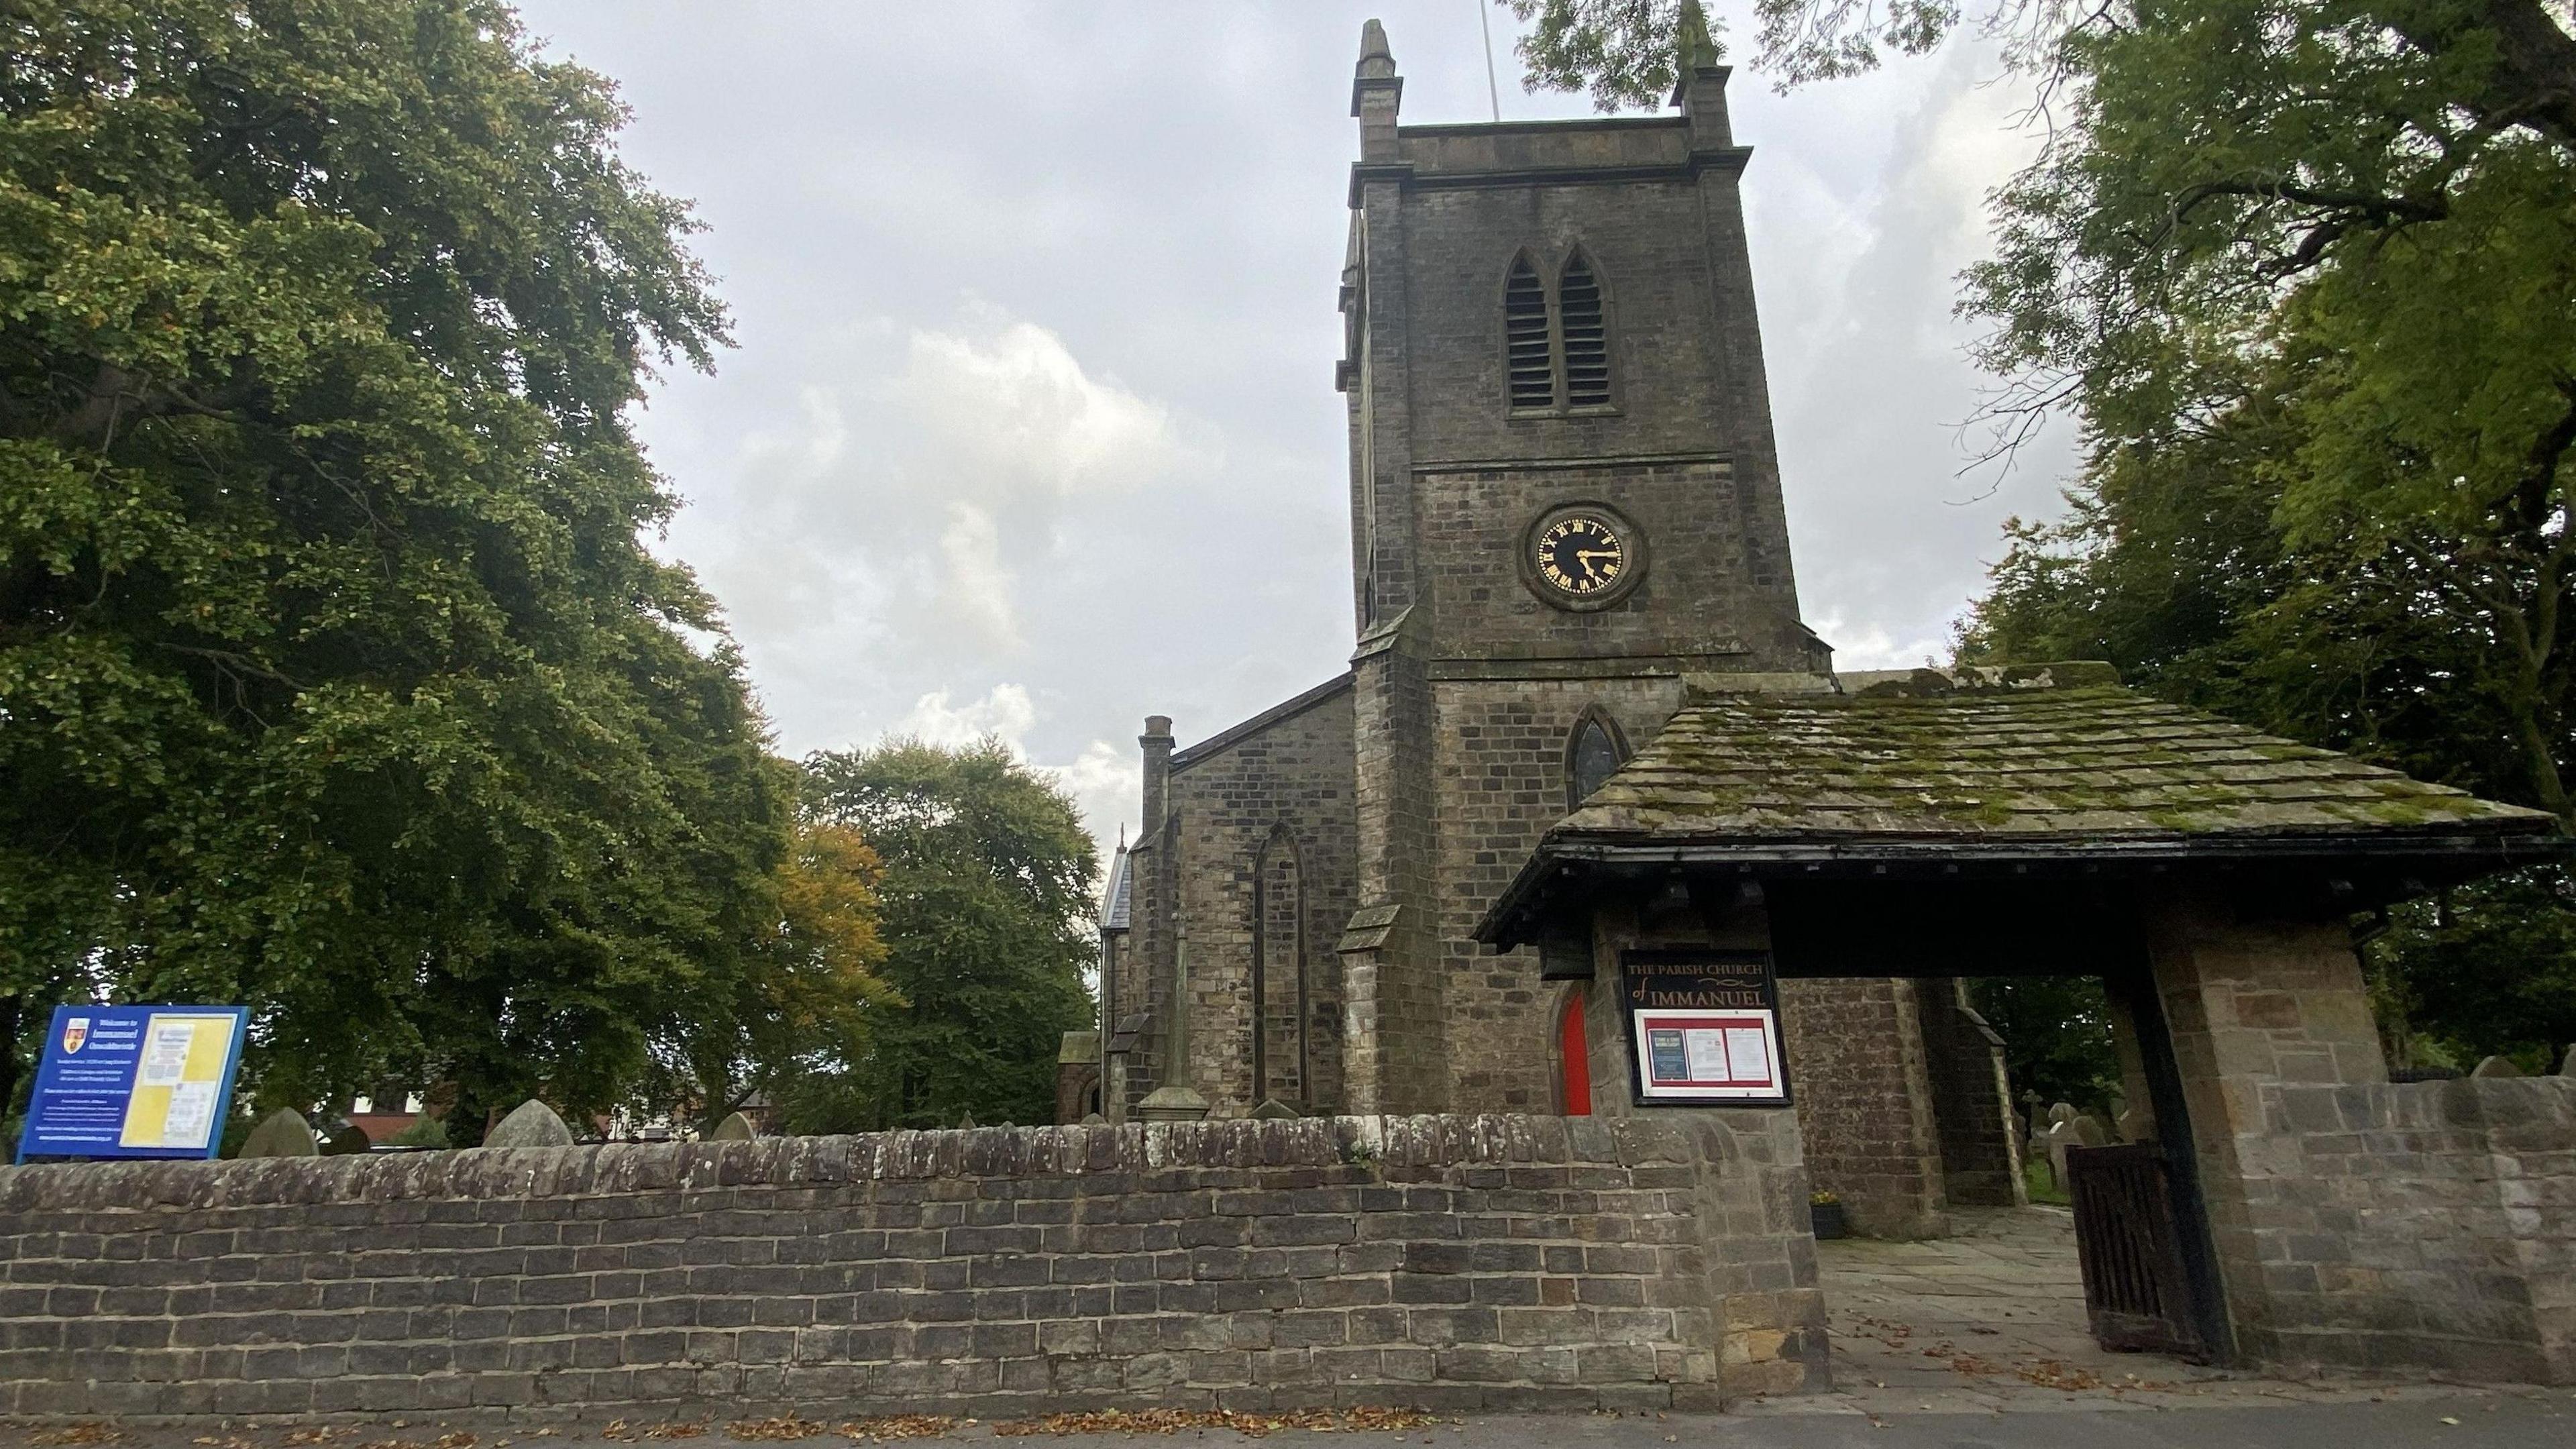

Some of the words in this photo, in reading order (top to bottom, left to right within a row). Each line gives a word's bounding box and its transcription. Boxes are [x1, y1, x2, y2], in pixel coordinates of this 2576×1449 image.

[1627, 965, 1654, 974] THE
[1658, 965, 1703, 974] PARISH
[1707, 965, 1762, 974] CHURCH
[1632, 977, 1648, 1002] of
[1651, 991, 1766, 1006] IMMANUEL
